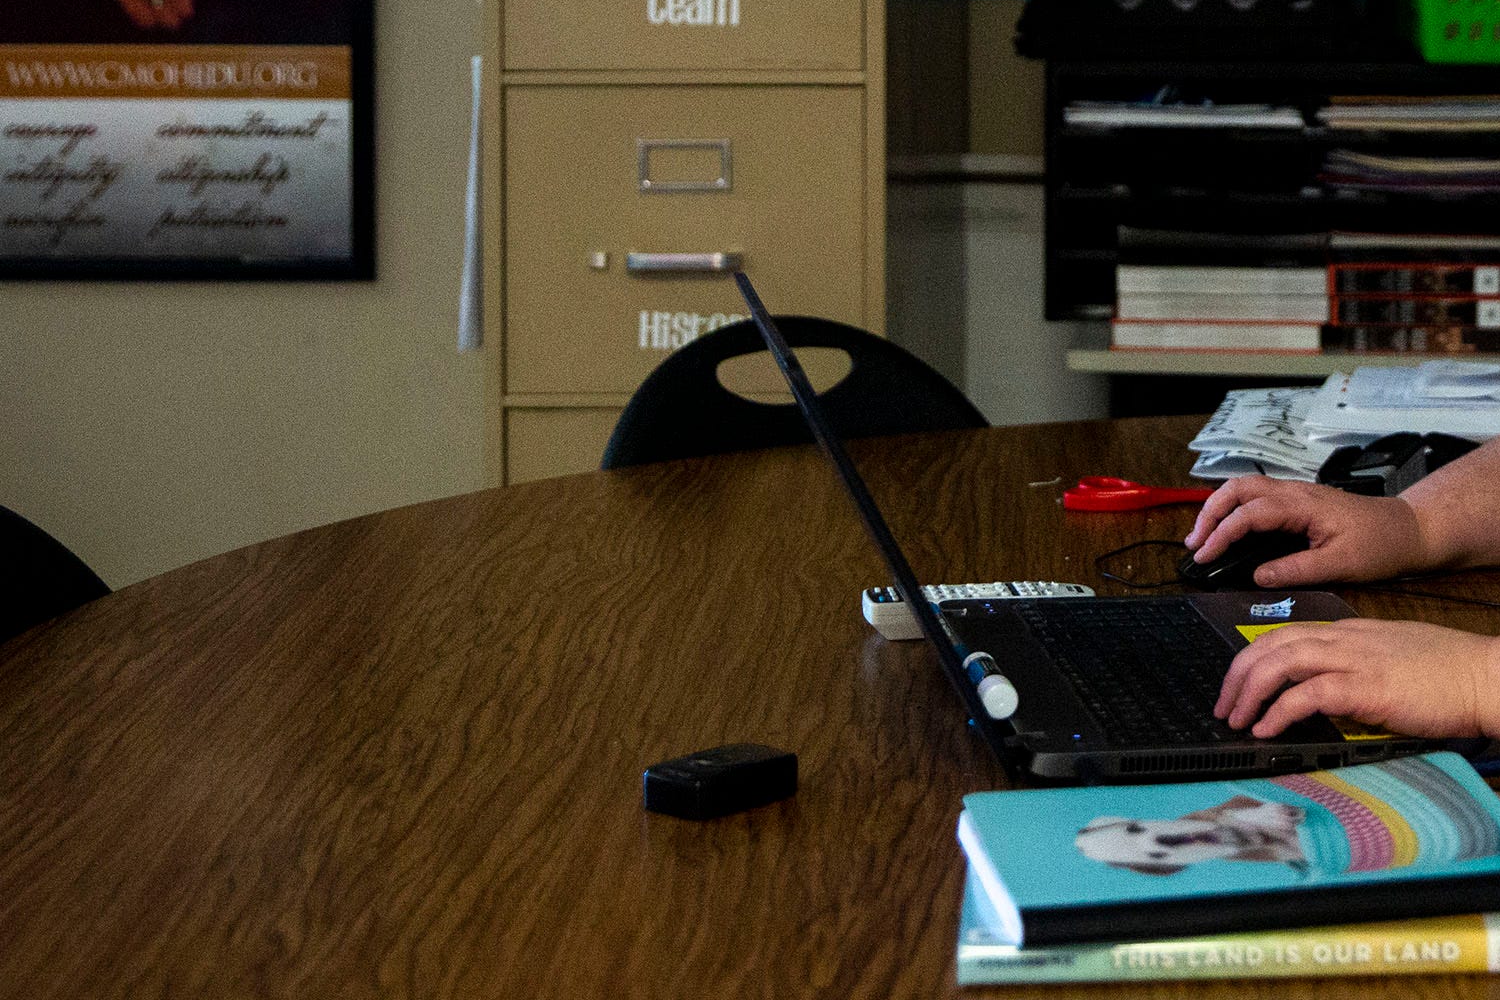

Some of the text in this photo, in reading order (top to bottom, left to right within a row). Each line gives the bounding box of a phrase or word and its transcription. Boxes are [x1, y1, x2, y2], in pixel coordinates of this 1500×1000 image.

[1111, 940, 1461, 969] THIS LAND IS OUR LAND
